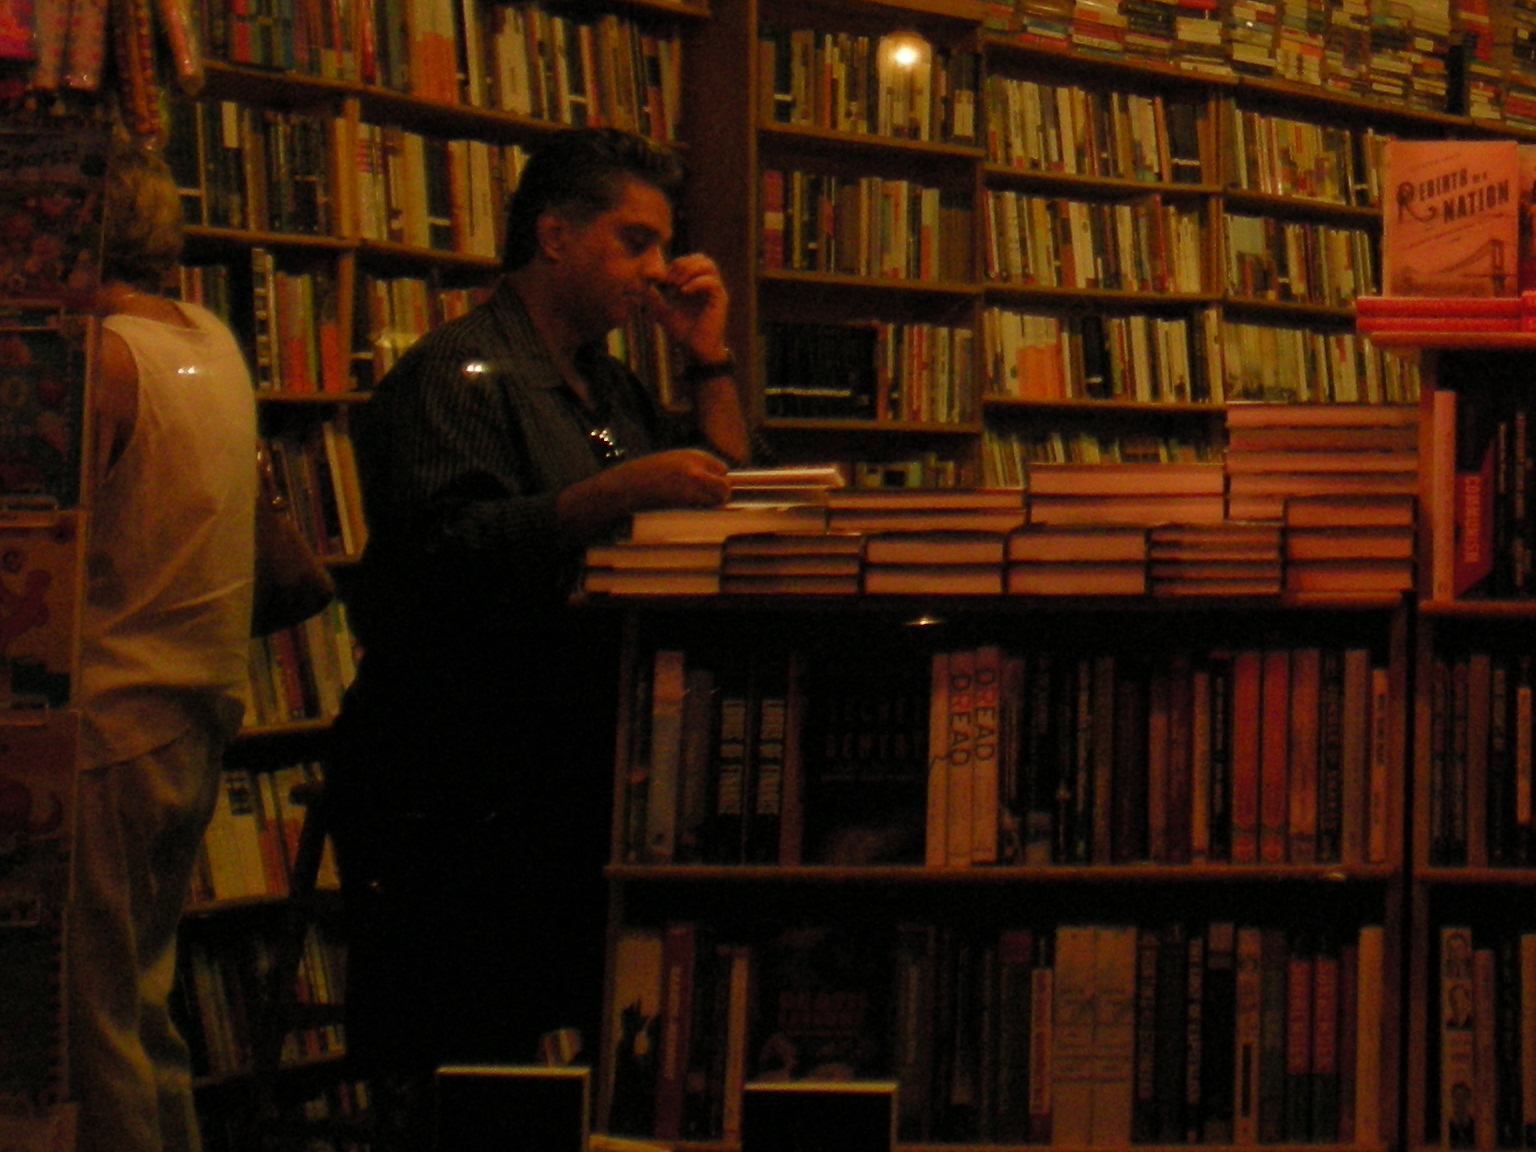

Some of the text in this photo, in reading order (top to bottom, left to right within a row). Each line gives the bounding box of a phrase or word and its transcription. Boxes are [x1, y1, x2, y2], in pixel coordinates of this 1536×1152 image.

[1443, 179, 1510, 223] NATION
[949, 671, 973, 766] DREAD
[974, 667, 997, 761] DREAD
